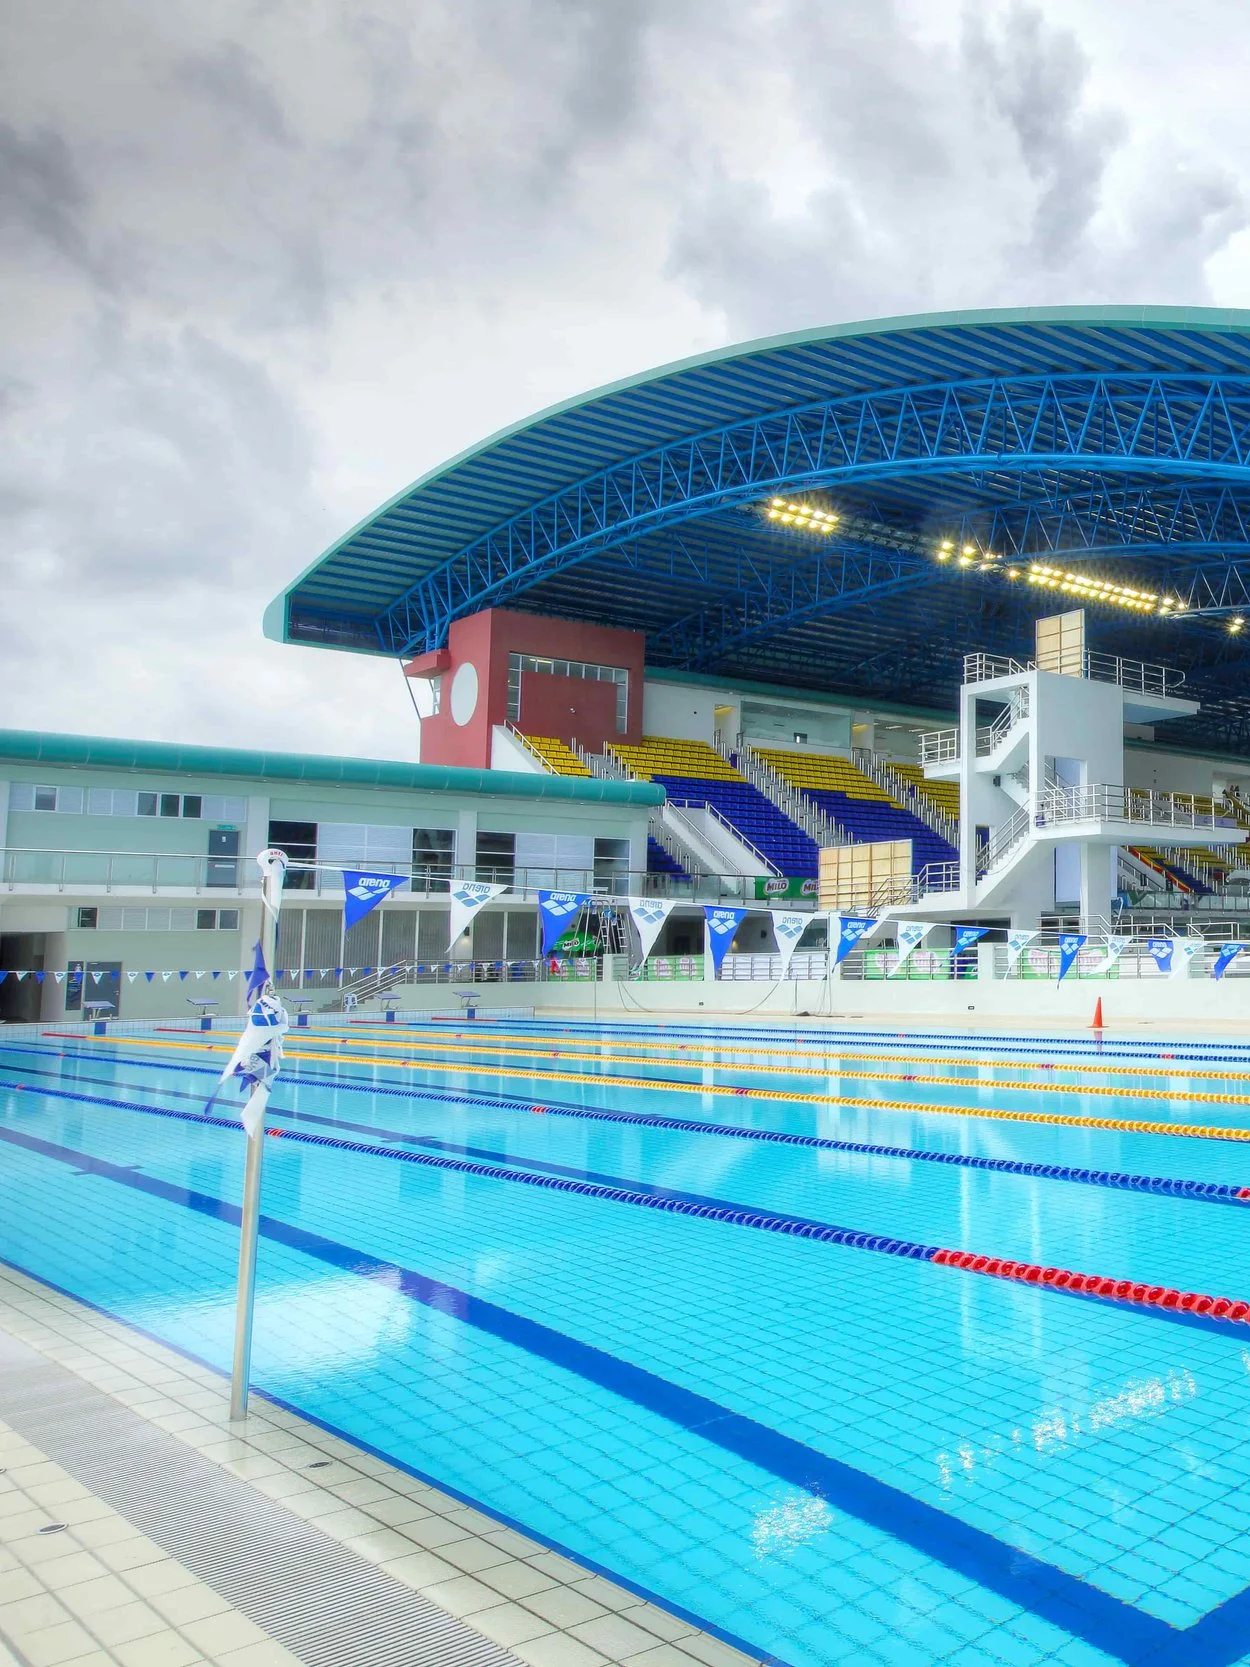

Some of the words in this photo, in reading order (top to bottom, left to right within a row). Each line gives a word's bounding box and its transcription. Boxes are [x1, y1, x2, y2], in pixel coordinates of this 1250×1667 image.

[358, 877, 391, 888] arena
[766, 882, 787, 892] MILO
[803, 883, 820, 892] MIL
[550, 892, 577, 902] arena
[713, 910, 735, 919] arena
